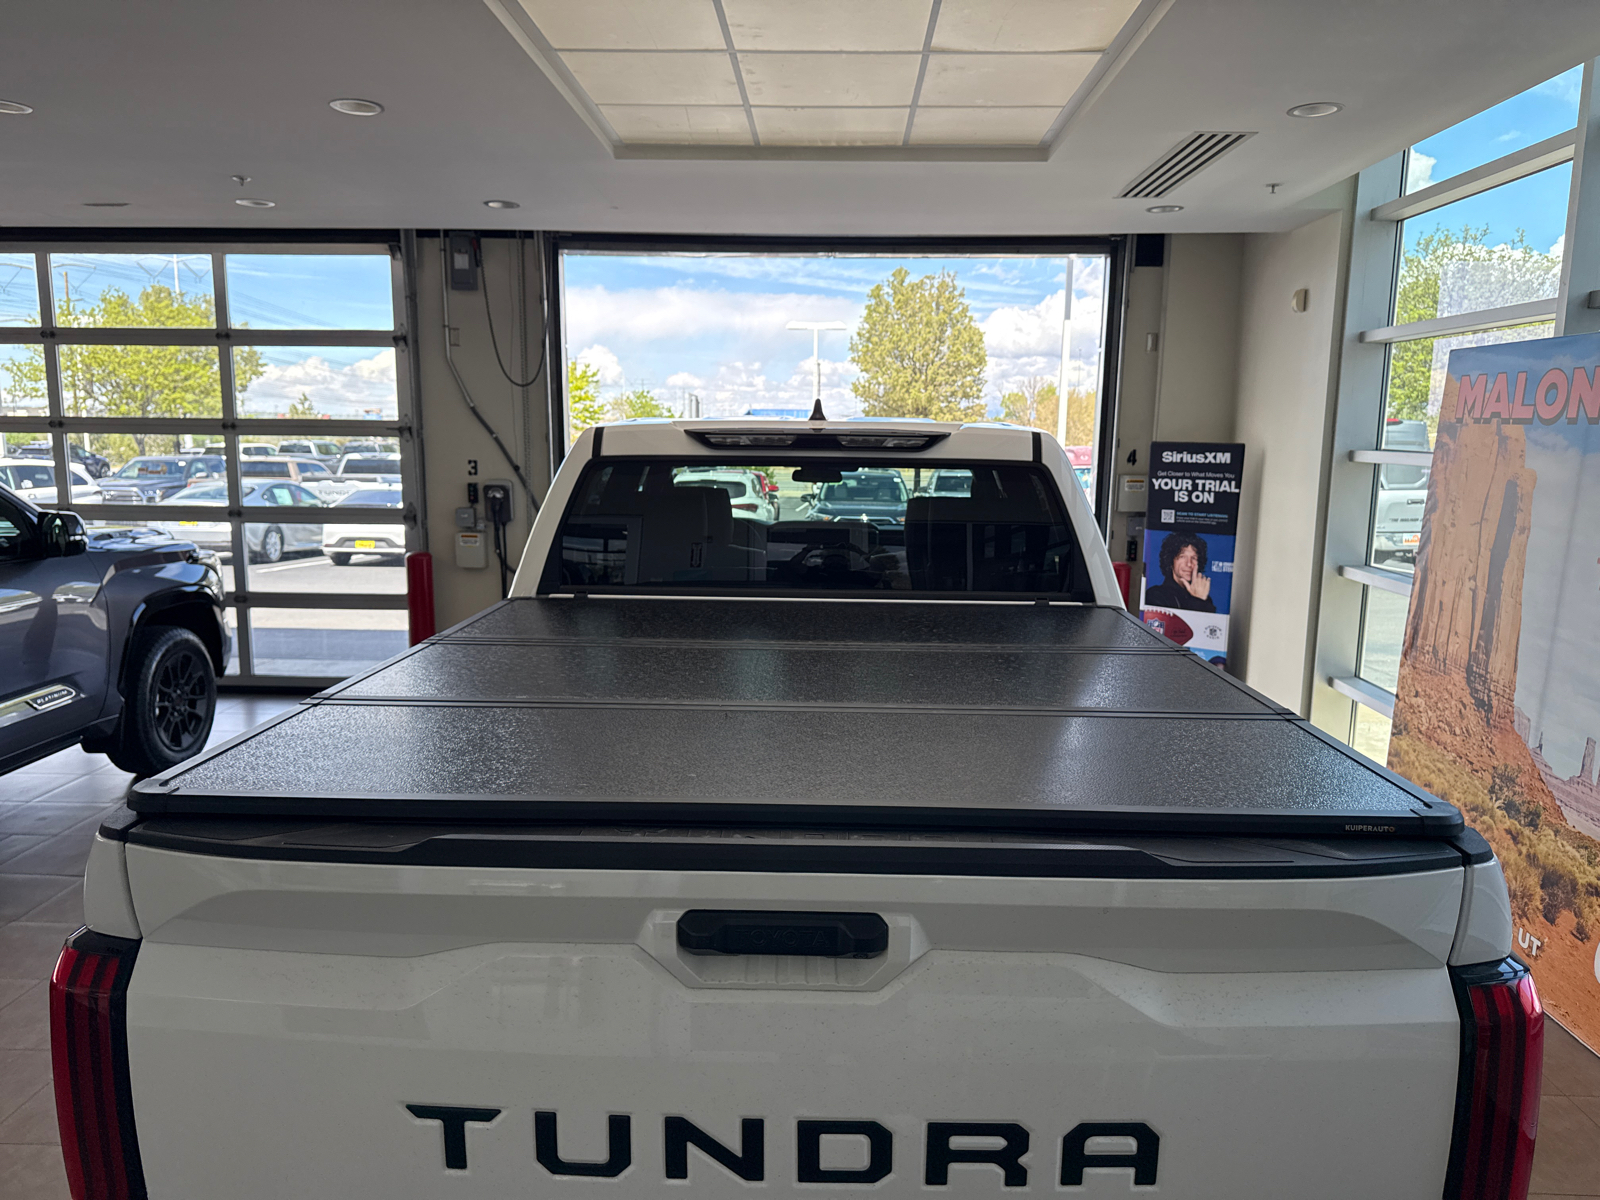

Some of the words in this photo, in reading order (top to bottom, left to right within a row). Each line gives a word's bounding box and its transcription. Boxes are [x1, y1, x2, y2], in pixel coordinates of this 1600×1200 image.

[1454, 365, 1600, 425] MALON
[1126, 449, 1137, 466] 4
[1161, 451, 1231, 464] SiriusXM
[467, 459, 478, 476] 3
[1151, 478, 1193, 490] YOUR
[1195, 480, 1239, 493] TRIAL
[1174, 490, 1189, 503] IS
[1191, 491, 1215, 504] ON
[1345, 824, 1396, 833] KUIPERAUTO
[734, 928, 830, 948] TOYOTA
[1517, 926, 1542, 957] UT
[405, 1104, 1161, 1187] TUNDRA
